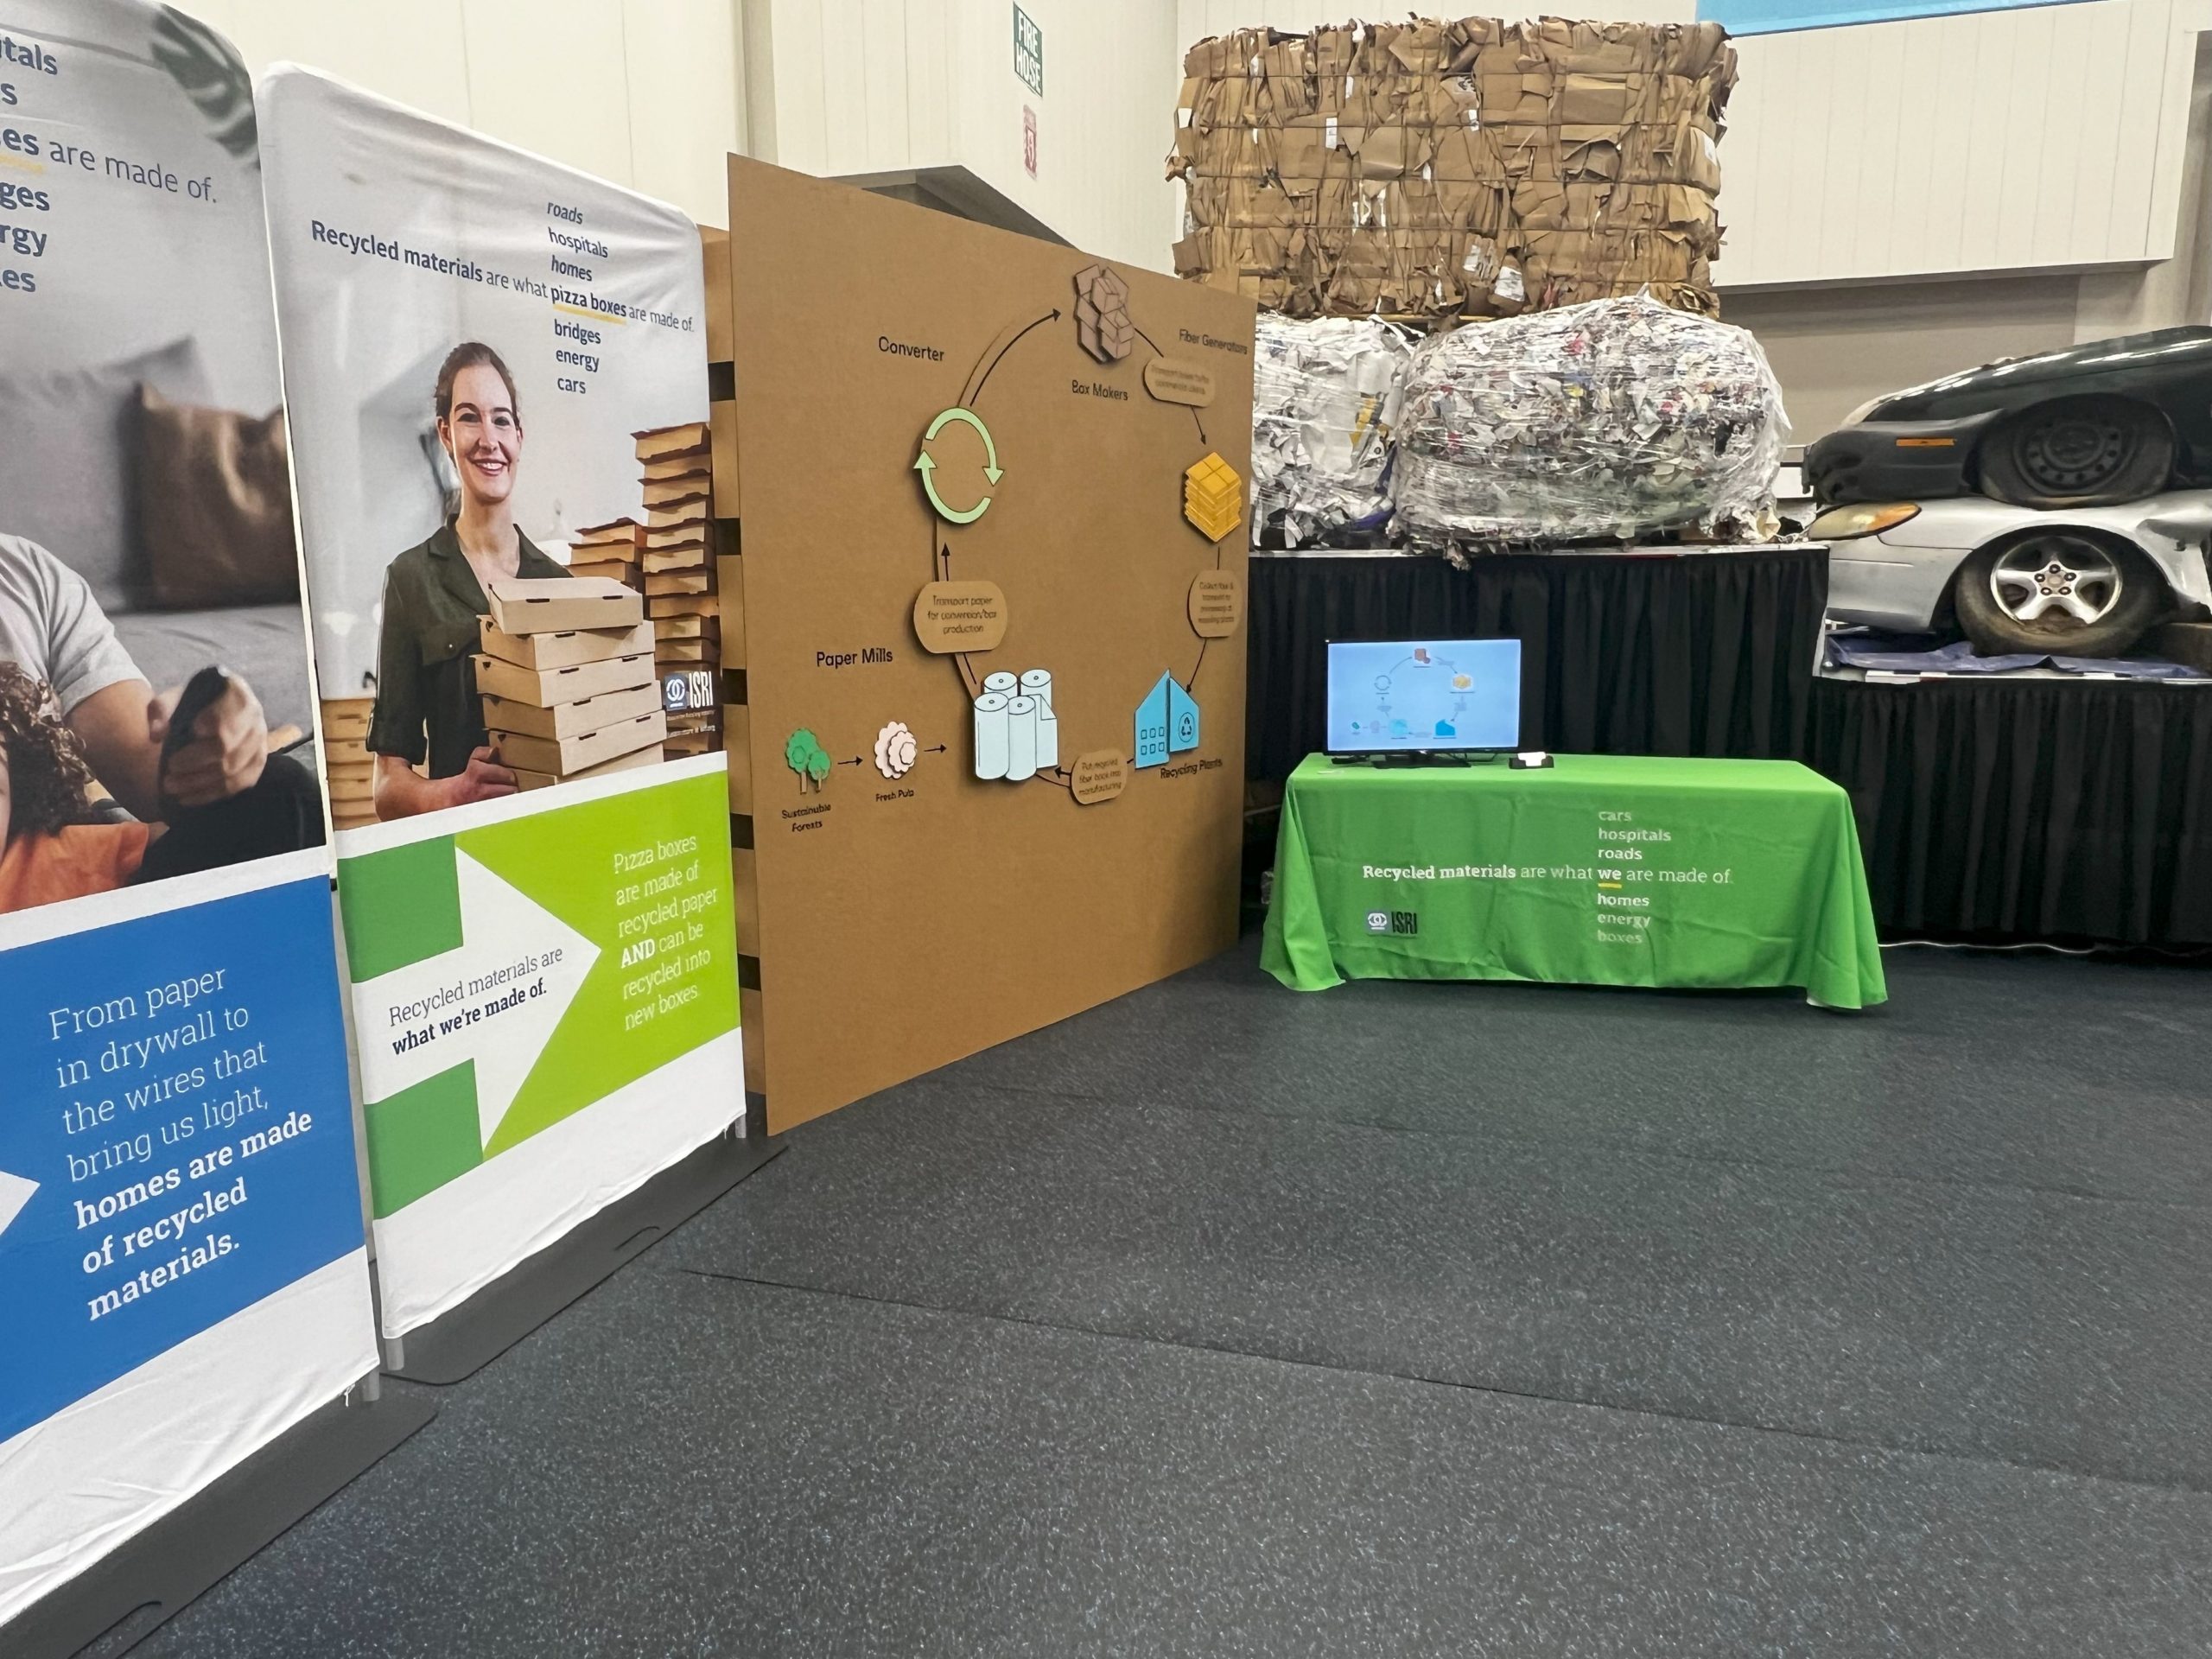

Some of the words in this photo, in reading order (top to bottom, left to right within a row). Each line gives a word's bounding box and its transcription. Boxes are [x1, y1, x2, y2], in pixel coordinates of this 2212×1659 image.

[1018, 10, 1039, 59] FIRE
[0, 36, 58, 75] tals
[1016, 42, 1041, 94] HOSE
[49, 141, 95, 171] are
[105, 156, 178, 193] made
[188, 177, 217, 203] of.
[547, 201, 583, 225] roads
[548, 226, 608, 258] hospitals
[311, 219, 399, 261] Recycled
[404, 246, 483, 283] materials
[486, 269, 509, 289] are
[513, 276, 549, 299] what
[550, 285, 587, 308] pizza
[591, 292, 626, 317] boxes
[628, 302, 647, 321] are
[650, 307, 679, 329] made
[550, 255, 593, 282] homes
[554, 319, 601, 345] bridges
[556, 349, 600, 372] energy
[879, 336, 944, 362] Converter
[557, 377, 586, 395] cars
[1071, 380, 1090, 397] Box
[1092, 383, 1128, 401] Makers
[927, 610, 939, 620] for
[970, 597, 993, 606] paper
[943, 625, 984, 634] production
[816, 650, 857, 668] Paper
[861, 647, 893, 664] Mills
[689, 671, 713, 709] ISRI
[1160, 764, 1198, 779] Recycling
[876, 792, 896, 803] Fresh
[781, 804, 831, 819] Sustainable
[1599, 810, 1632, 822] cars
[791, 821, 823, 832] Forests
[1599, 827, 1671, 843] hospitals
[614, 852, 654, 875] Pizza
[658, 836, 697, 860] boxes
[1598, 848, 1643, 860] roads
[616, 887, 639, 906] are
[644, 868, 683, 897] made
[686, 861, 699, 881] of
[1363, 865, 1435, 881] Recycled
[1439, 864, 1516, 879] materials
[1520, 867, 1546, 879] are
[1550, 865, 1592, 880] what
[1598, 868, 1622, 880] we
[1626, 869, 1654, 881] are
[1659, 868, 1707, 883] made
[618, 899, 679, 938] recycled
[682, 888, 718, 917] paper
[1598, 893, 1649, 906] homes
[1391, 911, 1417, 934] ISRI
[1598, 913, 1650, 929] energy
[620, 938, 657, 969] AND
[659, 933, 684, 953] can
[688, 922, 703, 942] be
[1598, 930, 1642, 944] boxes
[390, 982, 466, 1027] Recycled
[468, 956, 538, 997] materials
[541, 947, 563, 968] are
[622, 962, 683, 1001] recycled
[686, 948, 711, 973] into
[48, 994, 137, 1040] From
[145, 968, 226, 1018] paper
[391, 1025, 435, 1056] what
[439, 1007, 481, 1037] we're
[485, 988, 526, 1020] made
[529, 978, 548, 1005] of.
[625, 1003, 655, 1031] new
[56, 1059, 91, 1089] in
[99, 1013, 216, 1073] drywall
[223, 1007, 249, 1032] to
[62, 1099, 115, 1135] the
[124, 1065, 206, 1112] wires
[213, 1040, 268, 1081] that
[67, 1131, 153, 1183] bring
[161, 1115, 194, 1145] us
[203, 1085, 270, 1130] light,
[73, 1166, 181, 1230] homes
[188, 1145, 233, 1180] are
[240, 1109, 313, 1159] made
[82, 1234, 116, 1274] of
[124, 1177, 248, 1257] recycled
[88, 1231, 240, 1322] materials.
